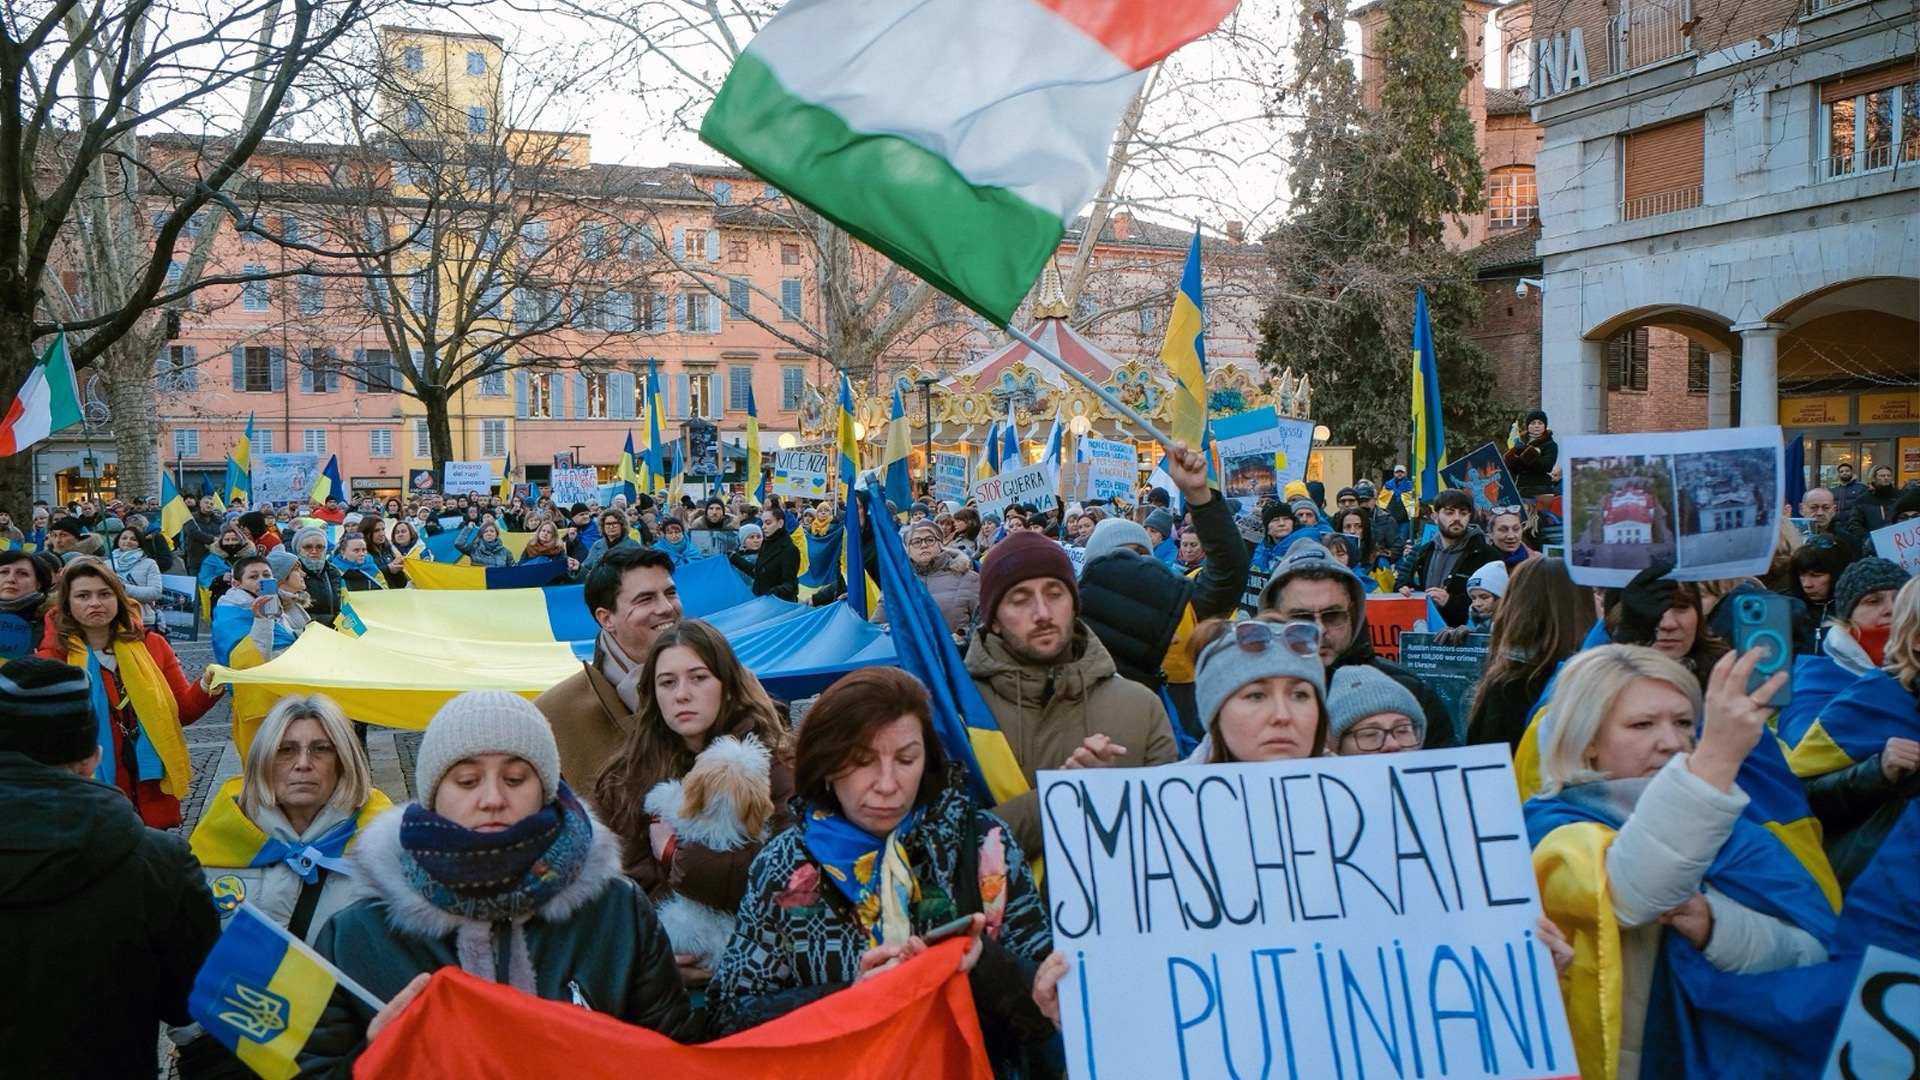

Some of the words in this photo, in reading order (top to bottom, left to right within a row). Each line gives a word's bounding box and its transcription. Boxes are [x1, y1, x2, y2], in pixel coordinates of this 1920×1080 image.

[777, 452, 828, 473] VICENZA
[975, 479, 1001, 504] STOP
[1002, 471, 1045, 497] GUERRA
[1367, 623, 1401, 647] LLO
[1407, 643, 1429, 651] Russian
[1045, 763, 1532, 939] SMASCHERATE
